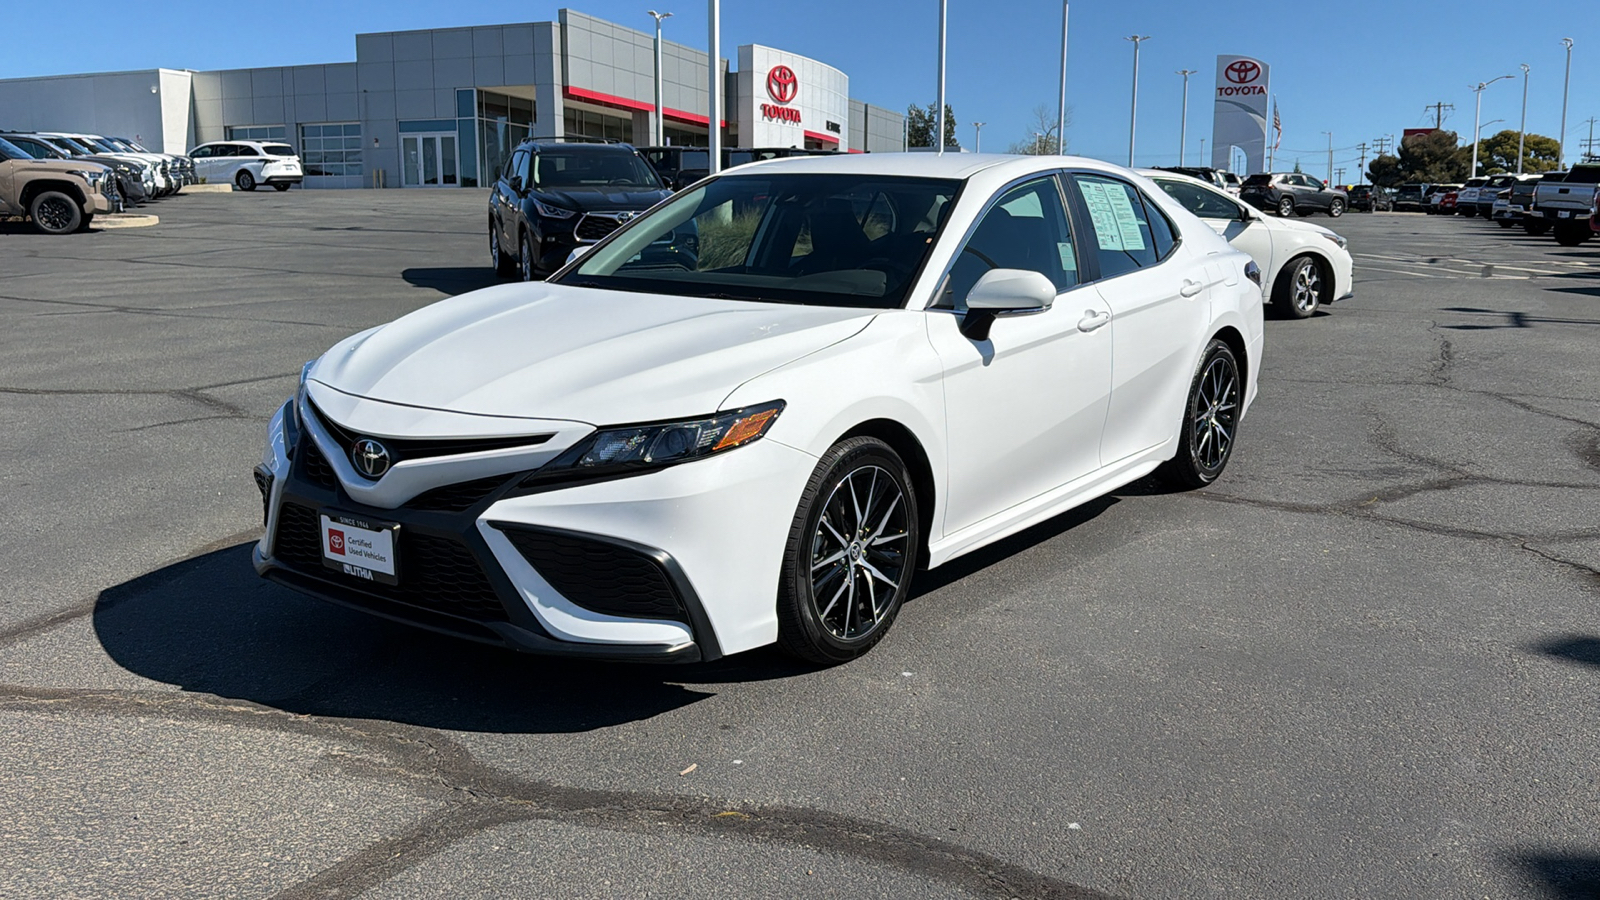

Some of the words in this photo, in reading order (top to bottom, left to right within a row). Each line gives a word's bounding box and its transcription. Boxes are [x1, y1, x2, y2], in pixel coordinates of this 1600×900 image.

[1217, 85, 1267, 96] TOYOTA
[762, 104, 801, 123] TOYOTA
[340, 517, 355, 526] SINCE
[357, 520, 369, 529] 1946
[348, 537, 372, 548] Certified
[349, 547, 363, 557] Used
[363, 550, 386, 562] Vehicles
[350, 565, 374, 580] LITHIA
